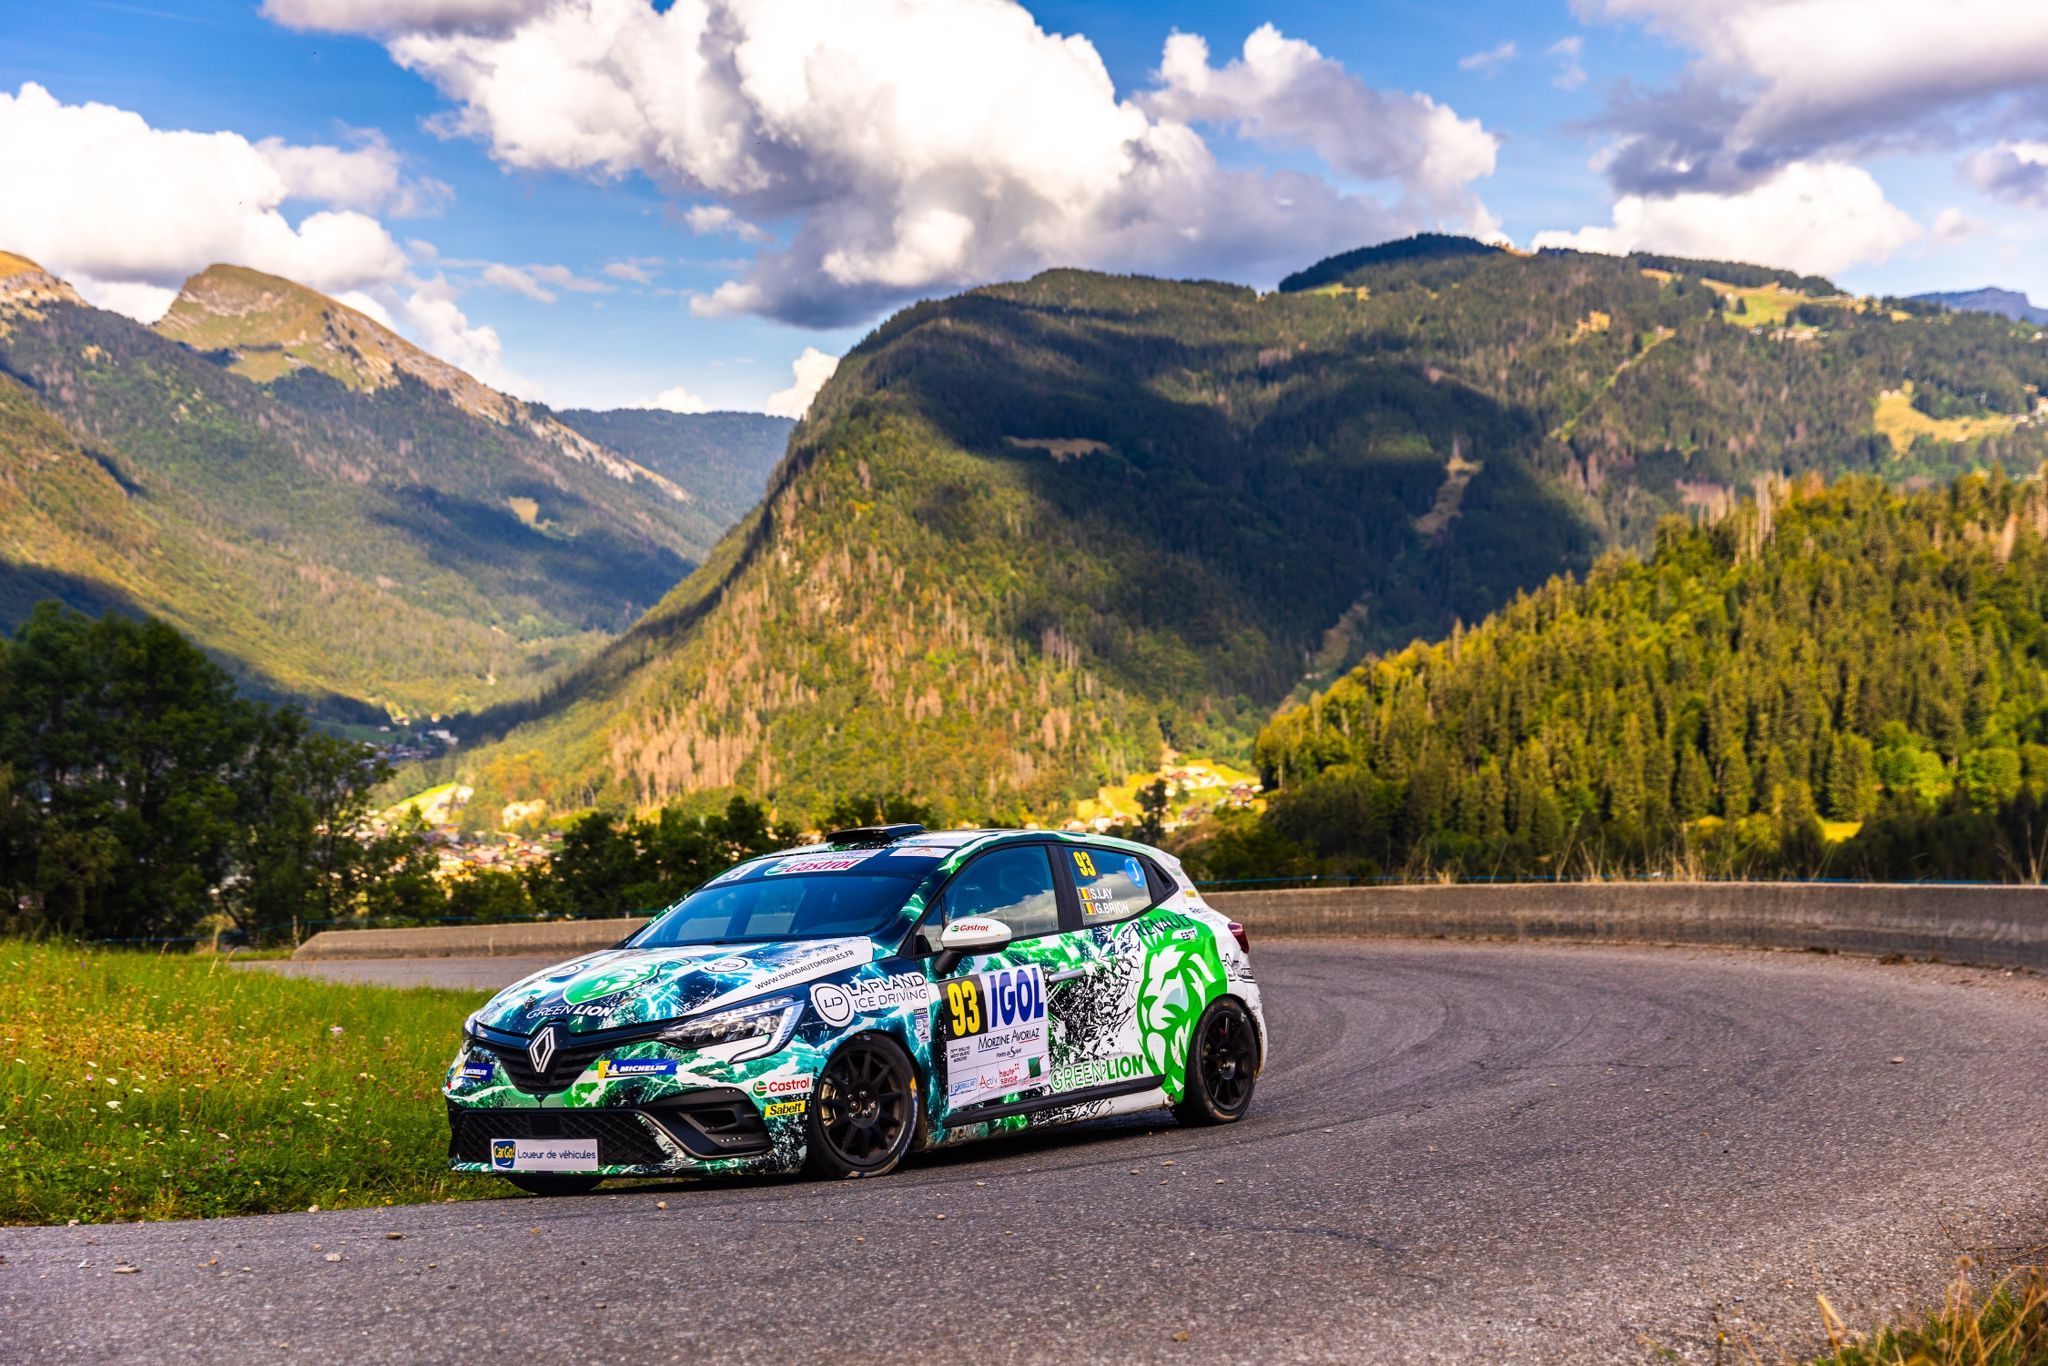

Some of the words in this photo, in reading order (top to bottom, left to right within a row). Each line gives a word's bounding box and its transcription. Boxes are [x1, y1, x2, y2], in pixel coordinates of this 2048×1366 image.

[785, 859, 861, 873] Castrol
[1073, 851, 1097, 877] 93
[1090, 887, 1113, 900] S.LAY
[1095, 901, 1130, 914] G.BRION
[960, 924, 989, 932] Castrol
[1132, 914, 1194, 937] RENAULT
[754, 949, 855, 990] WWW.DAVIDAUTOMOBILES.FR
[846, 974, 925, 997] LAPLAND
[854, 996, 876, 1010] ICE
[878, 988, 928, 1006] DRIVING
[946, 980, 980, 1037] 93
[989, 967, 1044, 1028] IGOL
[526, 1004, 574, 1019] GREEN
[573, 1004, 616, 1017] LION
[978, 1035, 1010, 1050] MORZINE
[465, 1066, 488, 1076] MICHELIN
[619, 1064, 668, 1073] MICHELIN
[1050, 1062, 1104, 1091] GREEN
[1106, 1054, 1144, 1080] LION
[768, 1077, 810, 1092] Castrol
[769, 1101, 802, 1116] Sabelt
[517, 1149, 545, 1159] Loueur
[547, 1149, 557, 1159] de
[559, 1148, 596, 1159] véhicules
